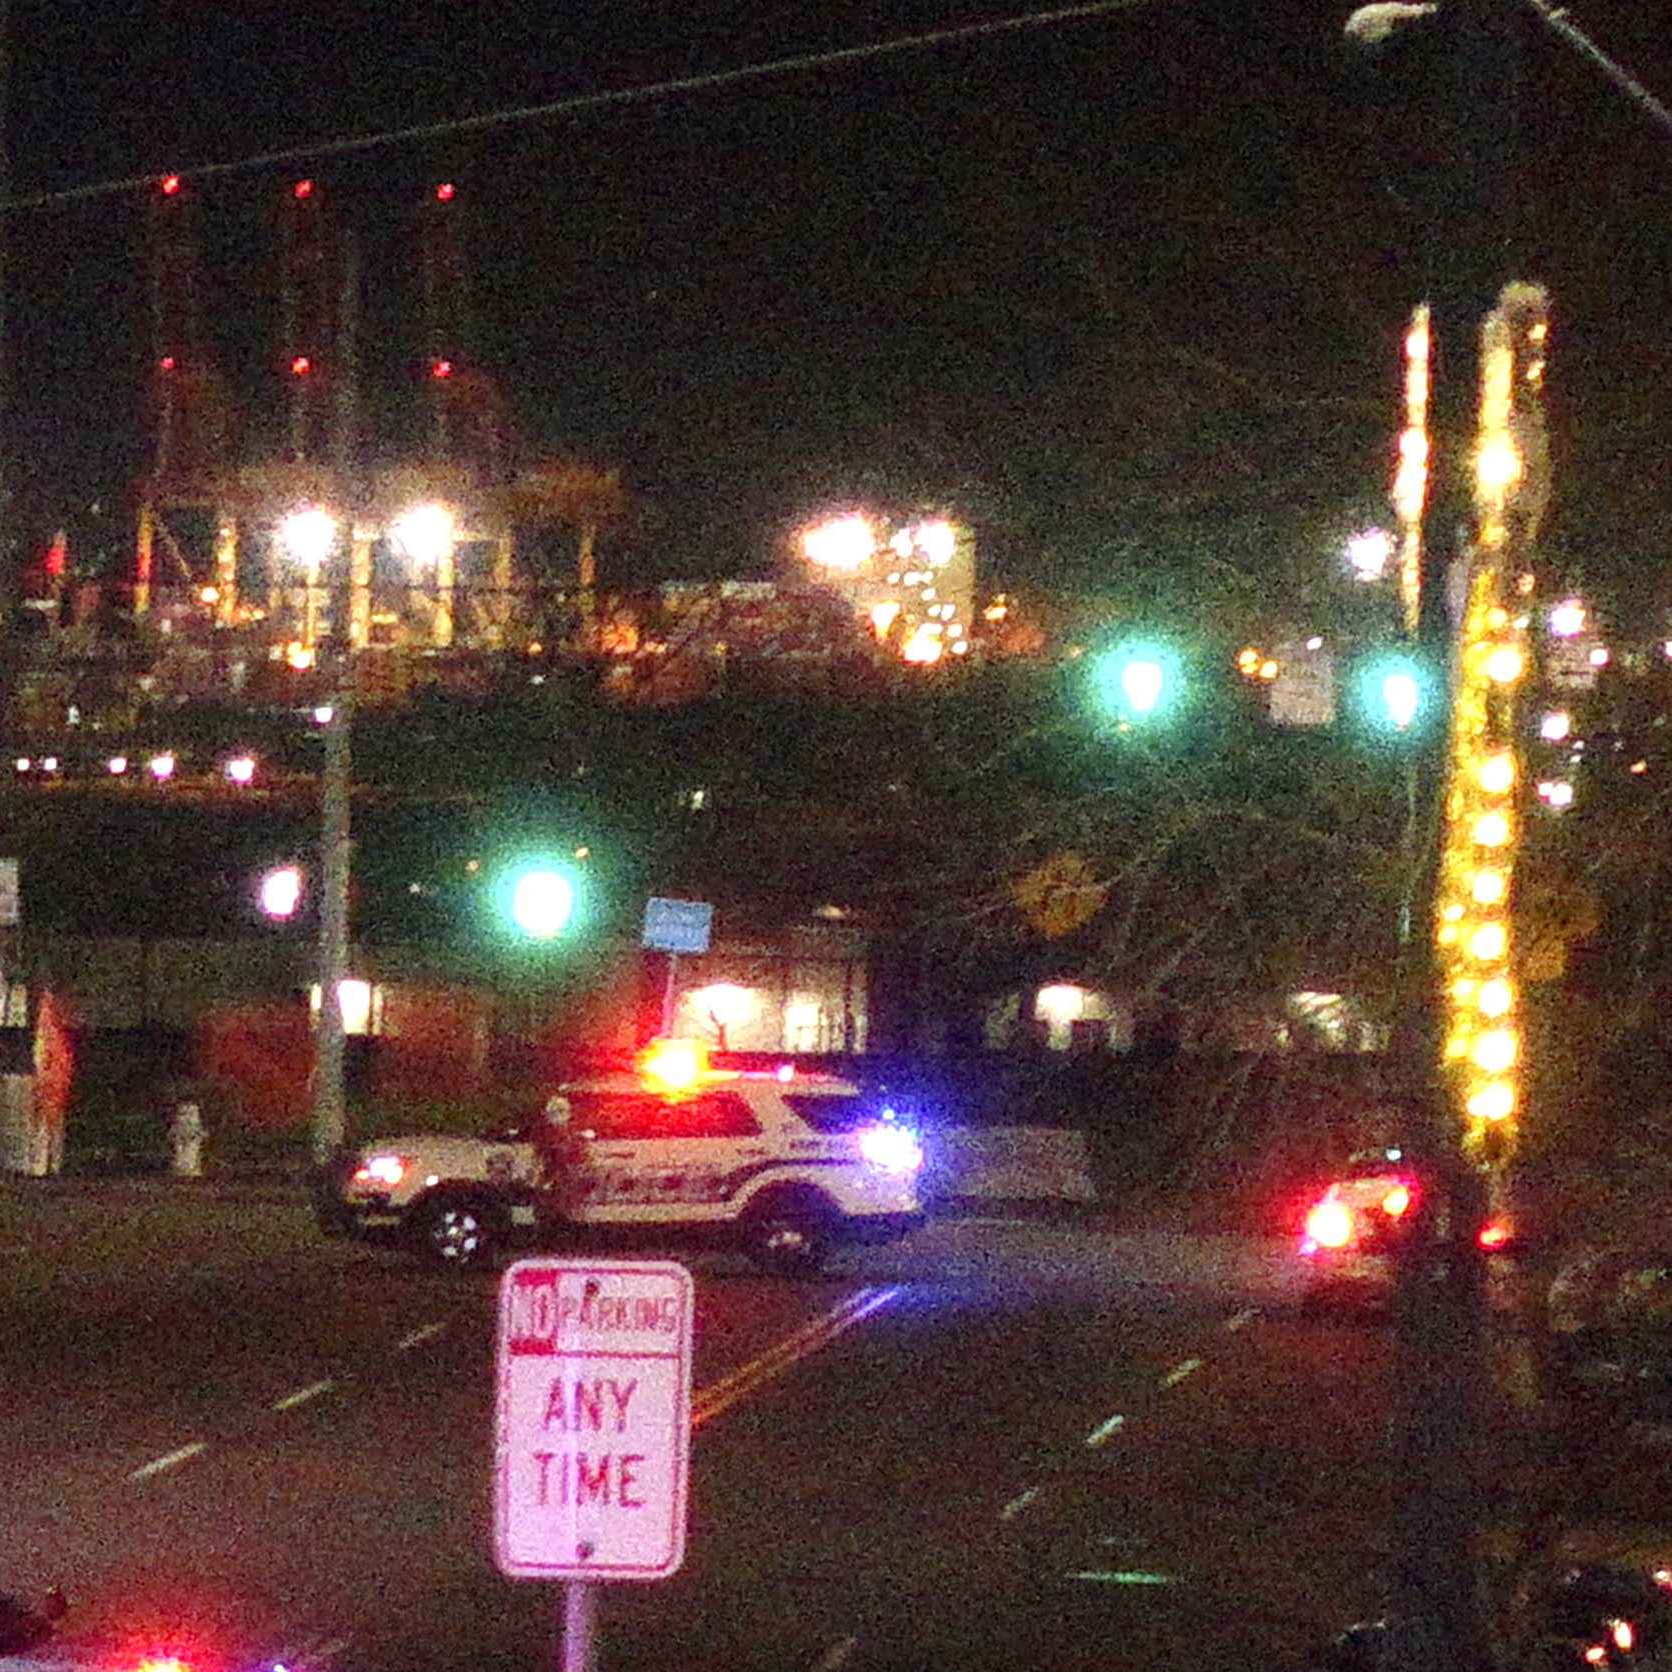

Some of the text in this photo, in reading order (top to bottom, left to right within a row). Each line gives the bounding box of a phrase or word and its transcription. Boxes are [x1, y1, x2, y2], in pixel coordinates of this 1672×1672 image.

[557, 1297, 678, 1334] PARKING
[541, 1378, 638, 1433] ANY
[532, 1451, 646, 1508] TIME
